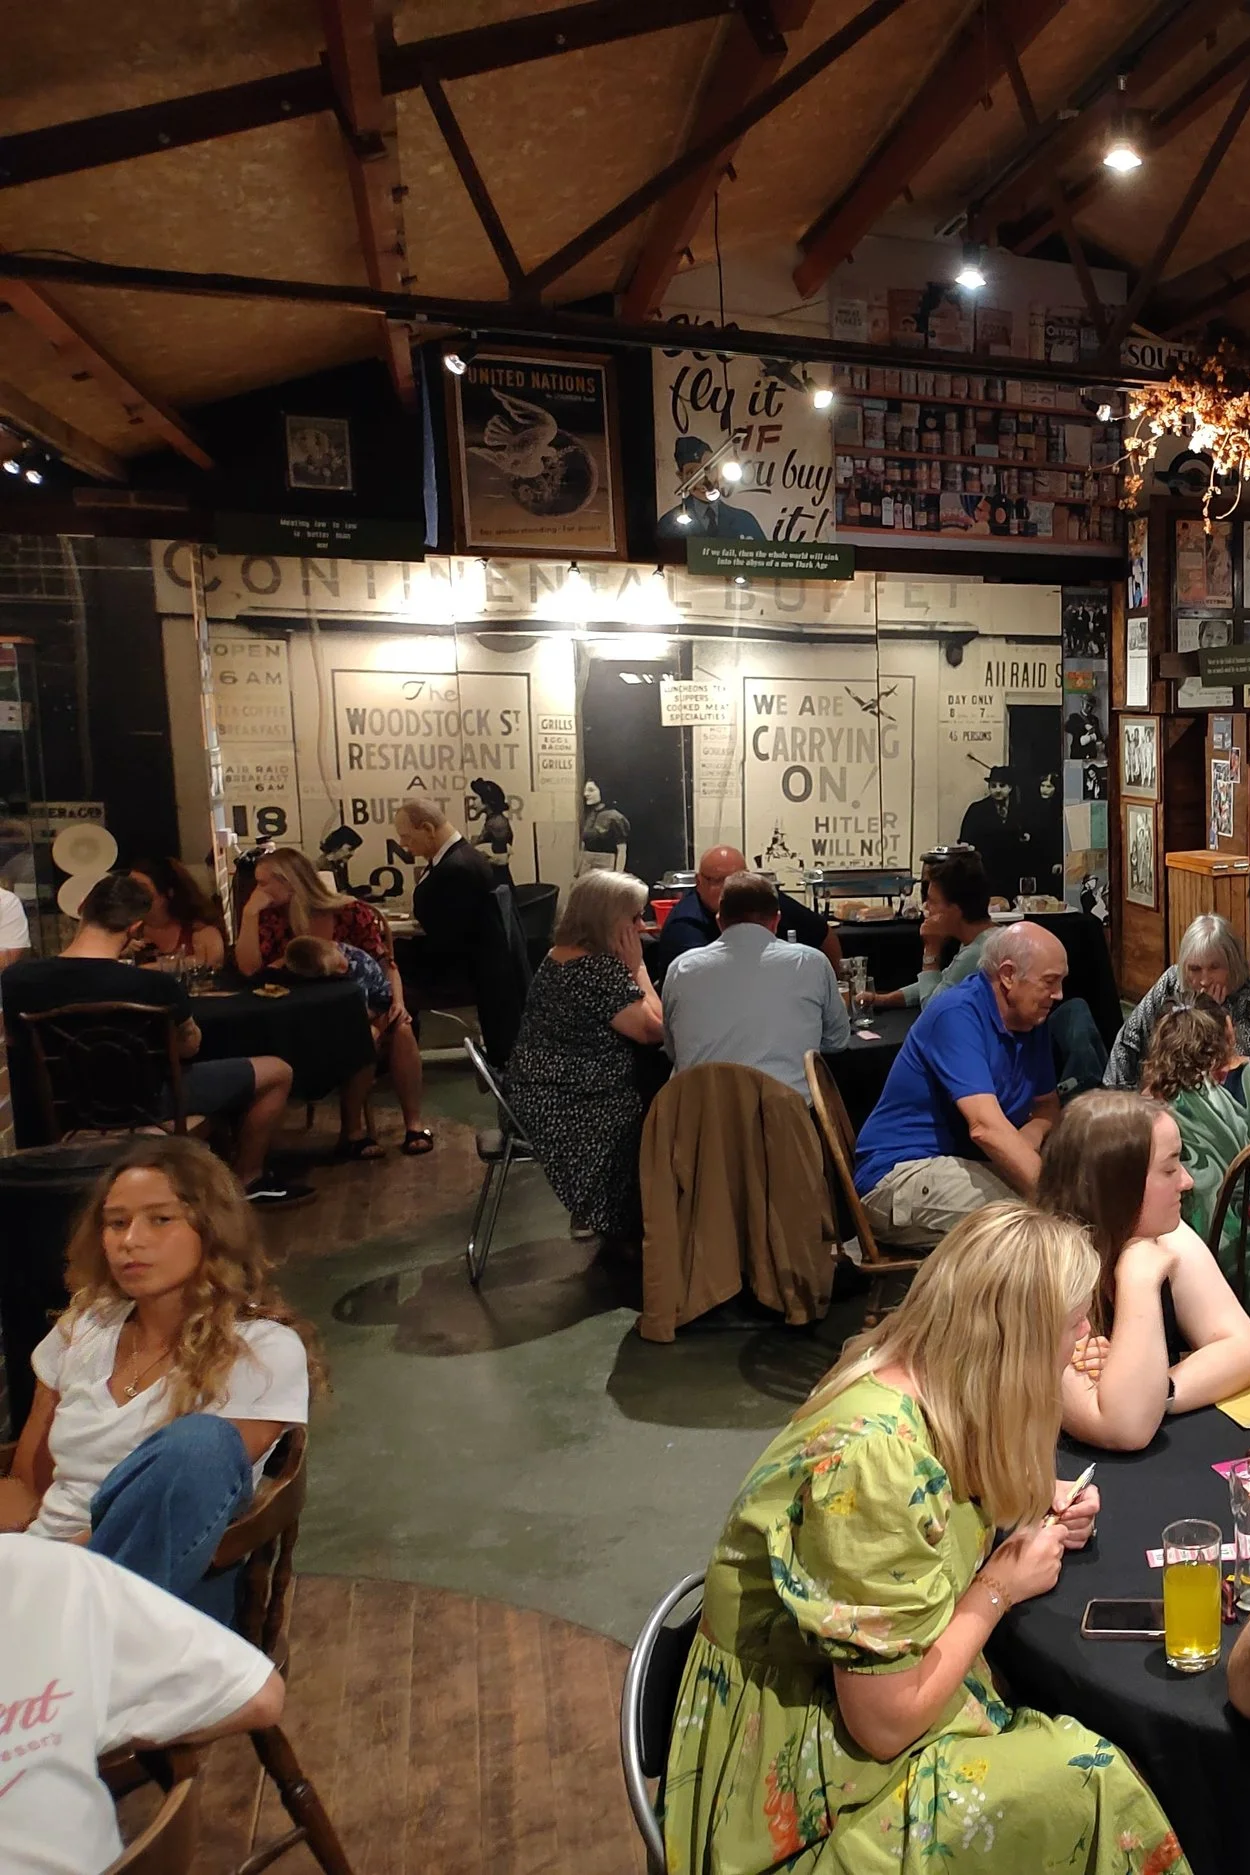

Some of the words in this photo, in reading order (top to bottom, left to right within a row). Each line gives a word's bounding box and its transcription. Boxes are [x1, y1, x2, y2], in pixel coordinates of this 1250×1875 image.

[468, 367, 525, 388] UNITED
[531, 371, 596, 394] NATIONS
[669, 366, 737, 433] fly
[748, 380, 786, 418] it
[782, 449, 833, 507] buy
[702, 548, 710, 556] If
[755, 550, 767, 558] the
[768, 551, 788, 559] whole
[789, 552, 808, 560] world
[809, 552, 822, 560] will
[824, 553, 839, 561] sink
[733, 558, 744, 566] the
[213, 644, 280, 657] OPEN
[219, 671, 238, 685] 6
[246, 671, 282, 684] AM
[1010, 662, 1047, 688] RAID
[402, 680, 458, 700] The
[753, 694, 788, 715] WE
[798, 695, 844, 716] ARE
[948, 695, 968, 705] DAY
[971, 695, 994, 705] ONLY
[346, 708, 491, 737] WOODSTOCK
[670, 713, 726, 721] SPECIALITIES
[541, 719, 573, 731] GRILLS
[752, 723, 900, 764] CARRYING
[963, 731, 992, 741] PERSONS
[348, 742, 520, 771] RESTAURANT
[226, 766, 250, 774] AIR
[542, 759, 573, 770] GRILLS
[226, 775, 289, 783] BREAKFAST
[407, 775, 468, 791] AND
[255, 783, 265, 791] 6
[815, 812, 898, 834] HITLER
[812, 838, 855, 857] WILL
[860, 834, 901, 857] NOT
